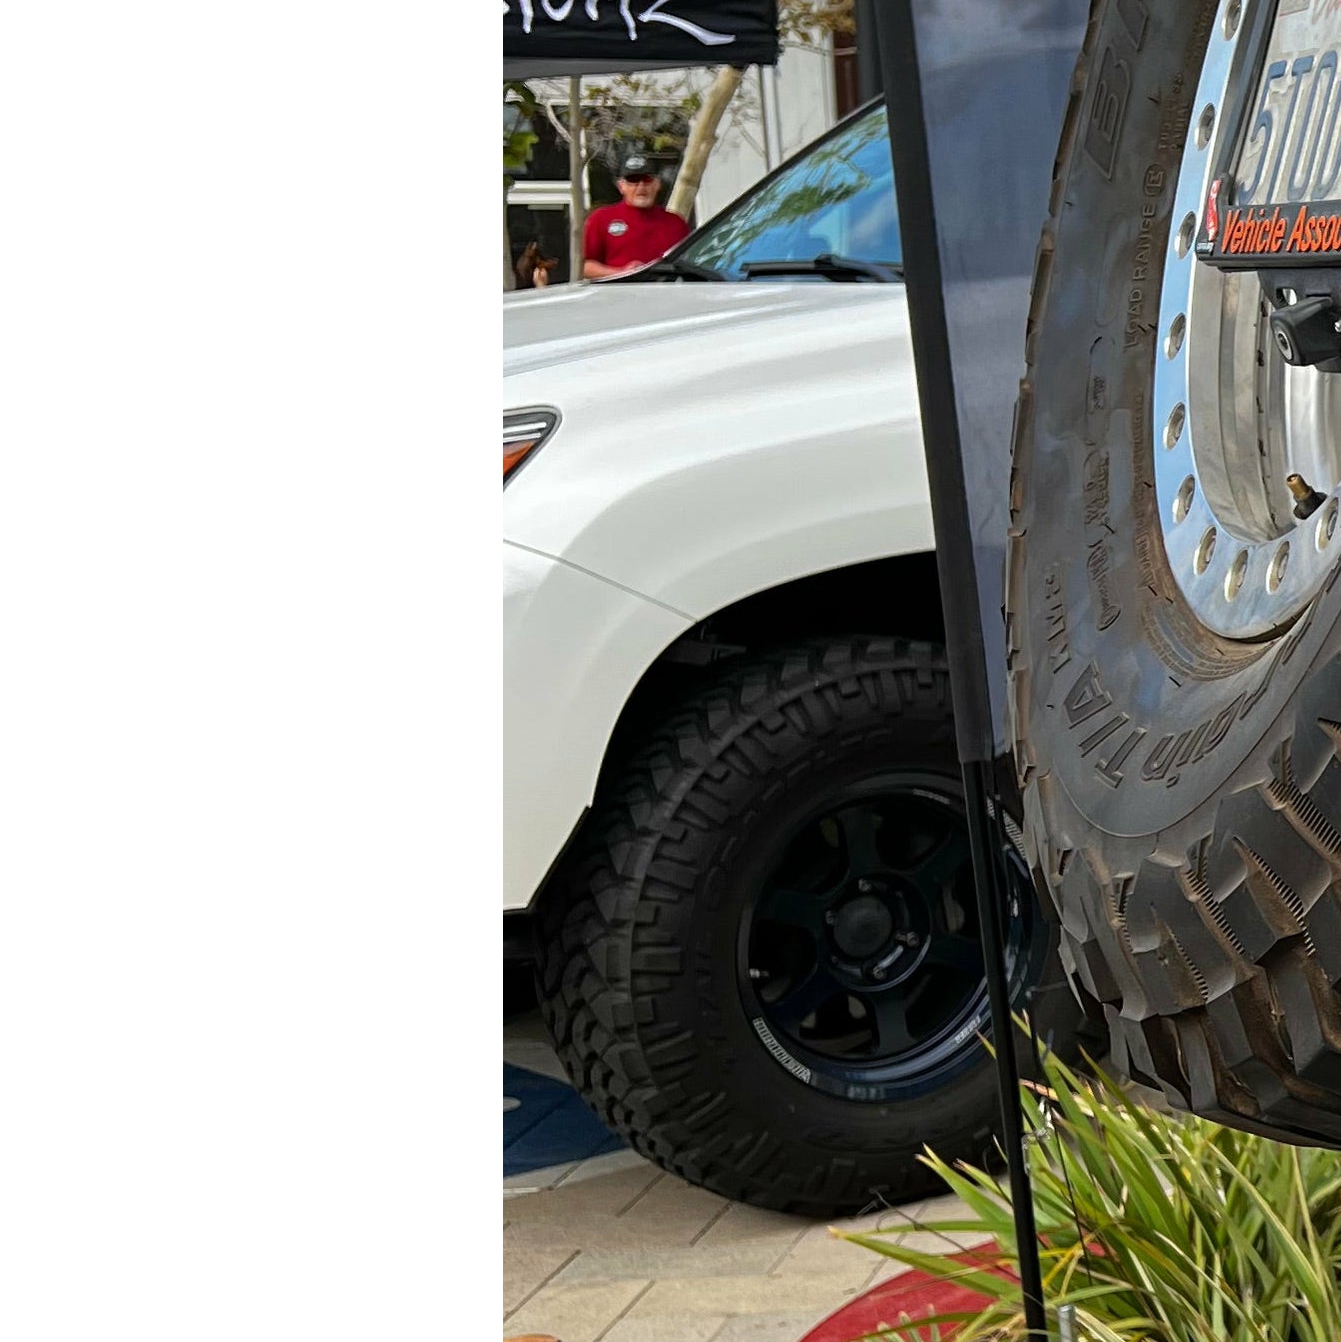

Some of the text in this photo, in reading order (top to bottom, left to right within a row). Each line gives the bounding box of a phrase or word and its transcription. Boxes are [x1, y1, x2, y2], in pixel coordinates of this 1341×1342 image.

[1132, 202, 1157, 281] RANGE
[1221, 206, 1286, 254] Vehicle
[1124, 288, 1144, 349] LOAD
